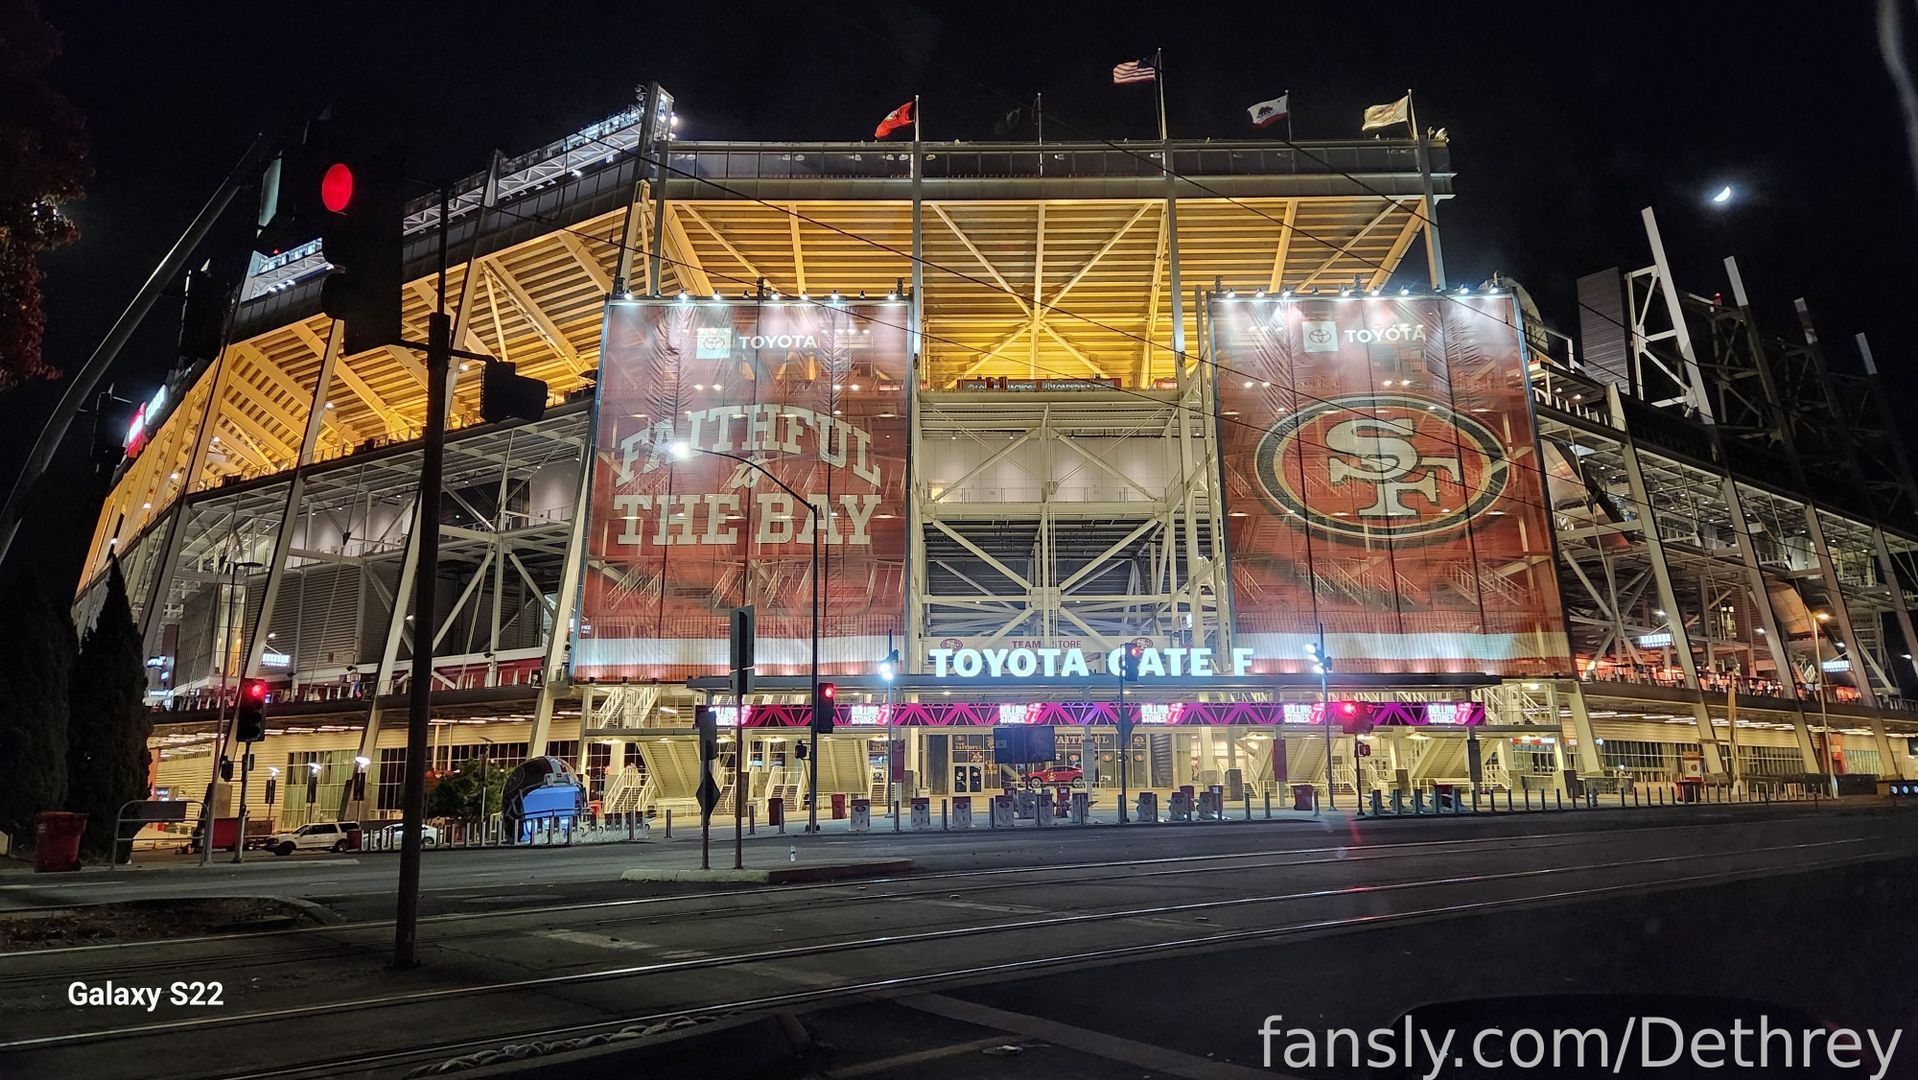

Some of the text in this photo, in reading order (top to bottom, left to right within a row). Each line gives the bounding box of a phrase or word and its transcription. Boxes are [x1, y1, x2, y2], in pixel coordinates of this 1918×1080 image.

[739, 334, 817, 350] TOYOTA
[1344, 326, 1426, 343] TOYOTA
[615, 404, 882, 488] FAITHFUL
[613, 493, 882, 546] THE BAY
[1012, 640, 1082, 649] TEAM STORE
[929, 648, 1089, 678] TOYOTA
[1233, 648, 1254, 677] F
